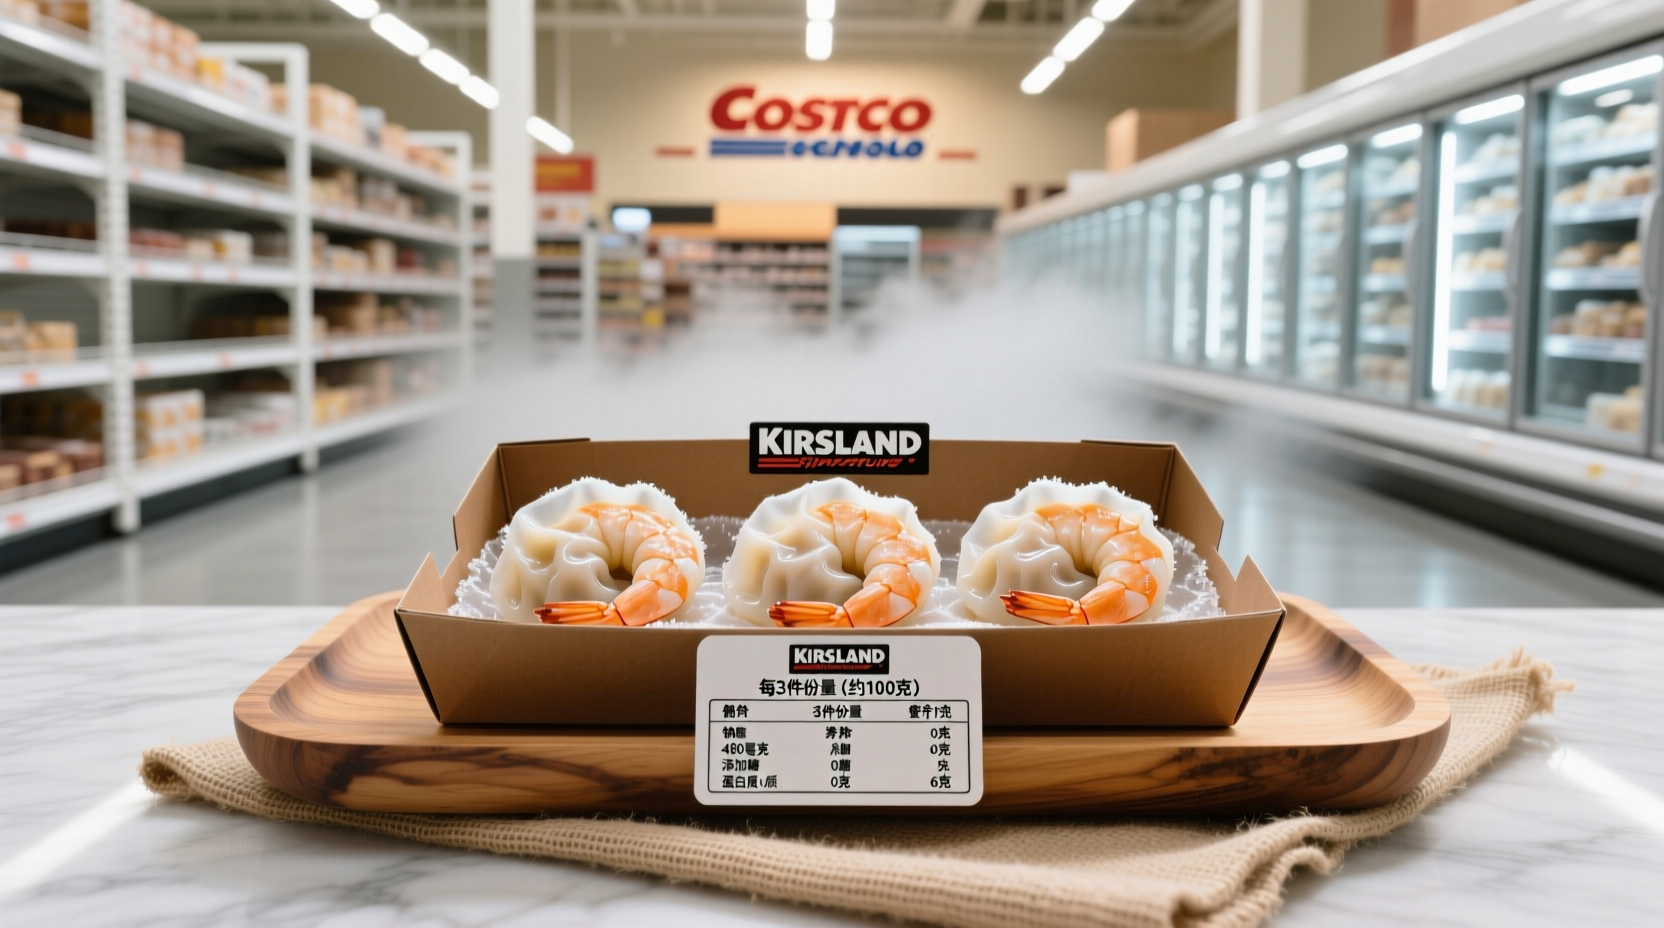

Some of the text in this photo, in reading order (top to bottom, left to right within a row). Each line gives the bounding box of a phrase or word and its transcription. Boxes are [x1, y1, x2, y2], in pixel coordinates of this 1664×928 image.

[710, 86, 932, 132] COSTCO
[758, 427, 922, 455] KIRSLAND
[794, 648, 886, 664] KIRSLAND
